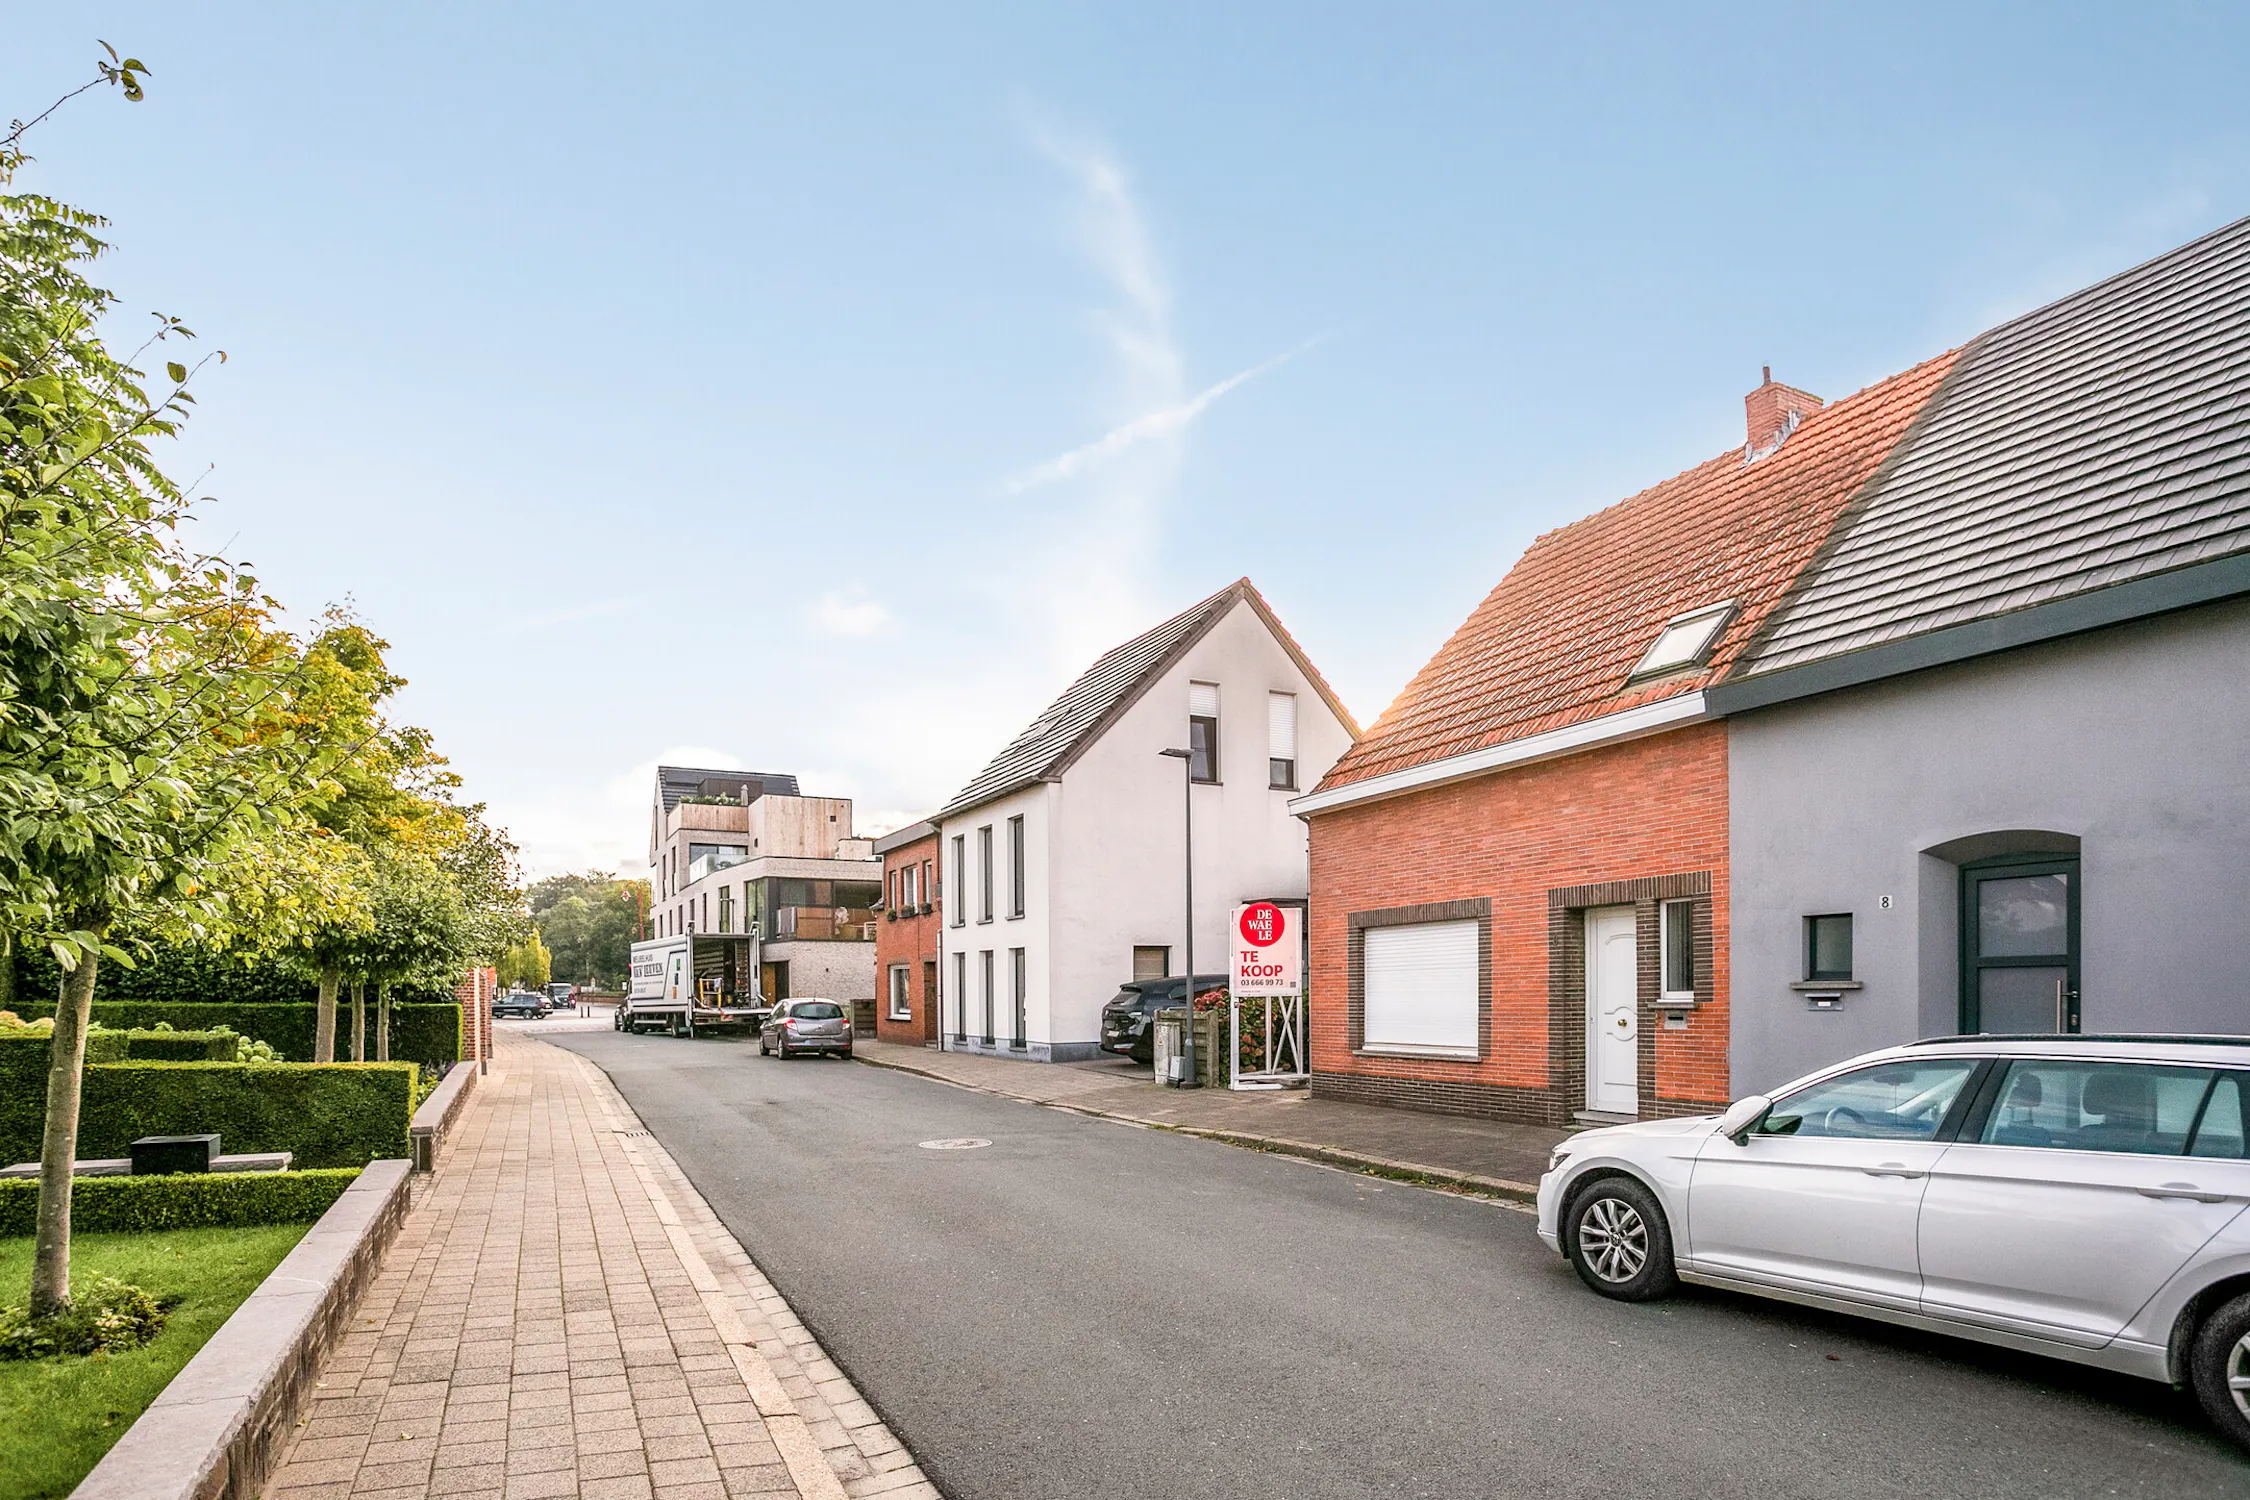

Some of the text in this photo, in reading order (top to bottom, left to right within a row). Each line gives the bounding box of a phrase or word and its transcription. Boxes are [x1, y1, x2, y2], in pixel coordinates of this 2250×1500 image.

[1881, 896, 1889, 908] 8
[1257, 909, 1273, 920] DE
[1248, 920, 1273, 930] WAE
[1258, 930, 1273, 941] LE
[1240, 950, 1259, 963] TE
[1241, 965, 1283, 977] KOOP
